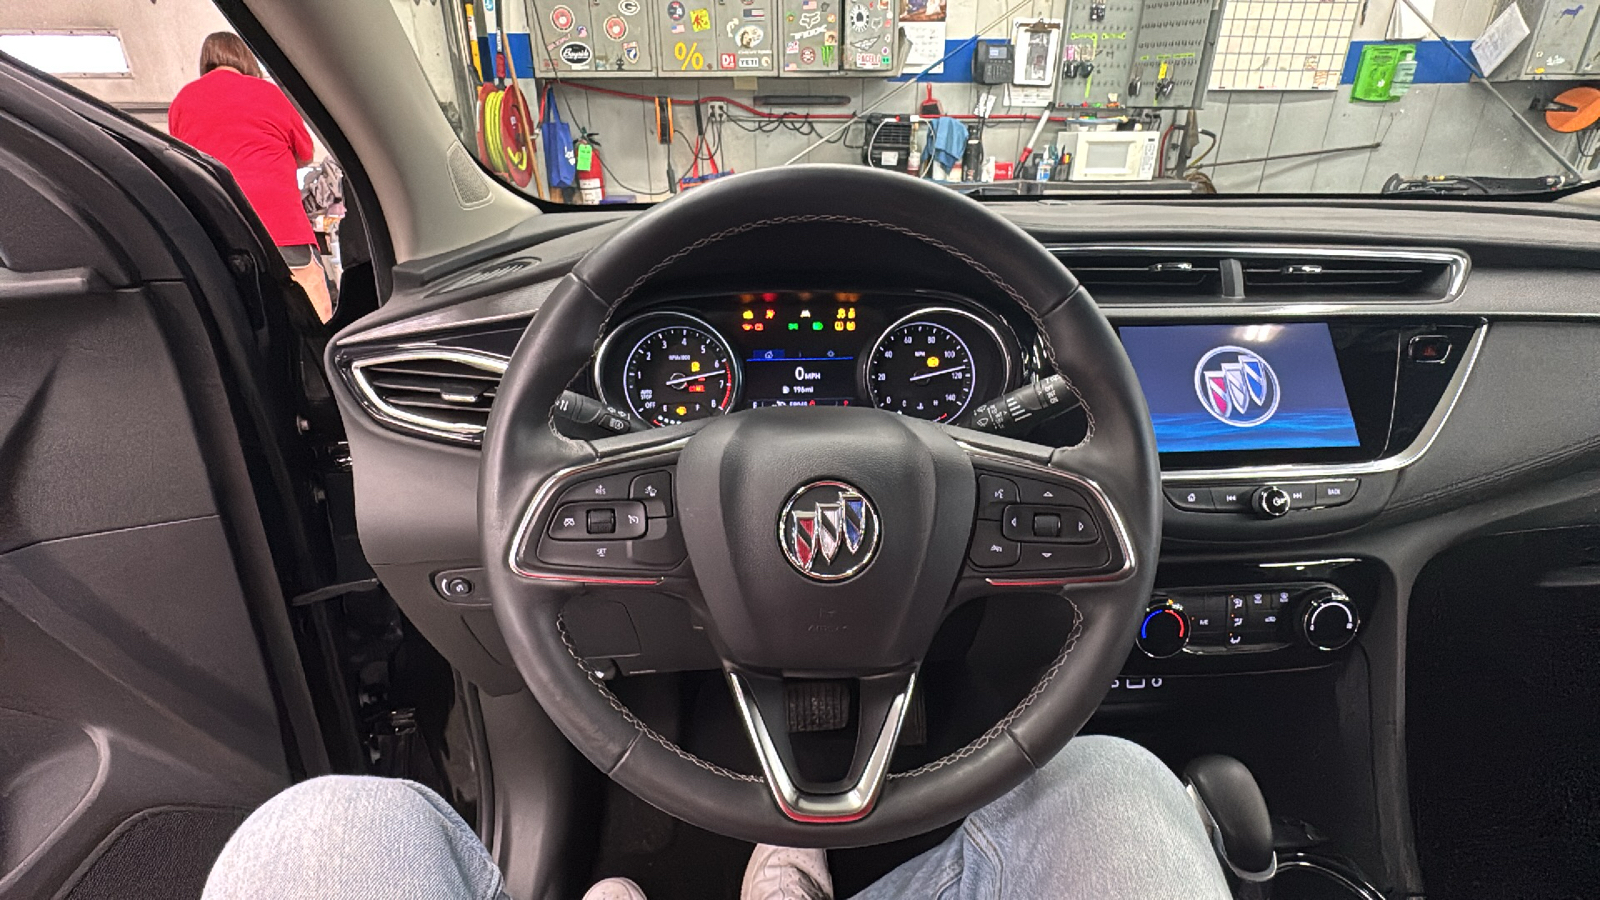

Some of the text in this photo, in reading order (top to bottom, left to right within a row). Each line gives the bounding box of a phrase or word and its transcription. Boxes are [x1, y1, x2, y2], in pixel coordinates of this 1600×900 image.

[681, 338, 687, 346] 4
[904, 336, 912, 344] 60
[927, 336, 936, 344] 80
[661, 341, 667, 349] 3
[701, 345, 706, 354] 5
[646, 352, 651, 360] 2
[884, 350, 893, 359] 40
[944, 350, 956, 359] 100
[714, 360, 720, 368] 6
[637, 371, 642, 379] 1
[877, 373, 886, 381] 20
[951, 372, 963, 380] 120
[719, 380, 724, 388] 7
[886, 396, 892, 404] 0
[945, 393, 956, 401] 140
[644, 401, 656, 409] OFF
[711, 399, 717, 408] 8
[662, 404, 668, 412] E
[1327, 488, 1341, 496] BACK
